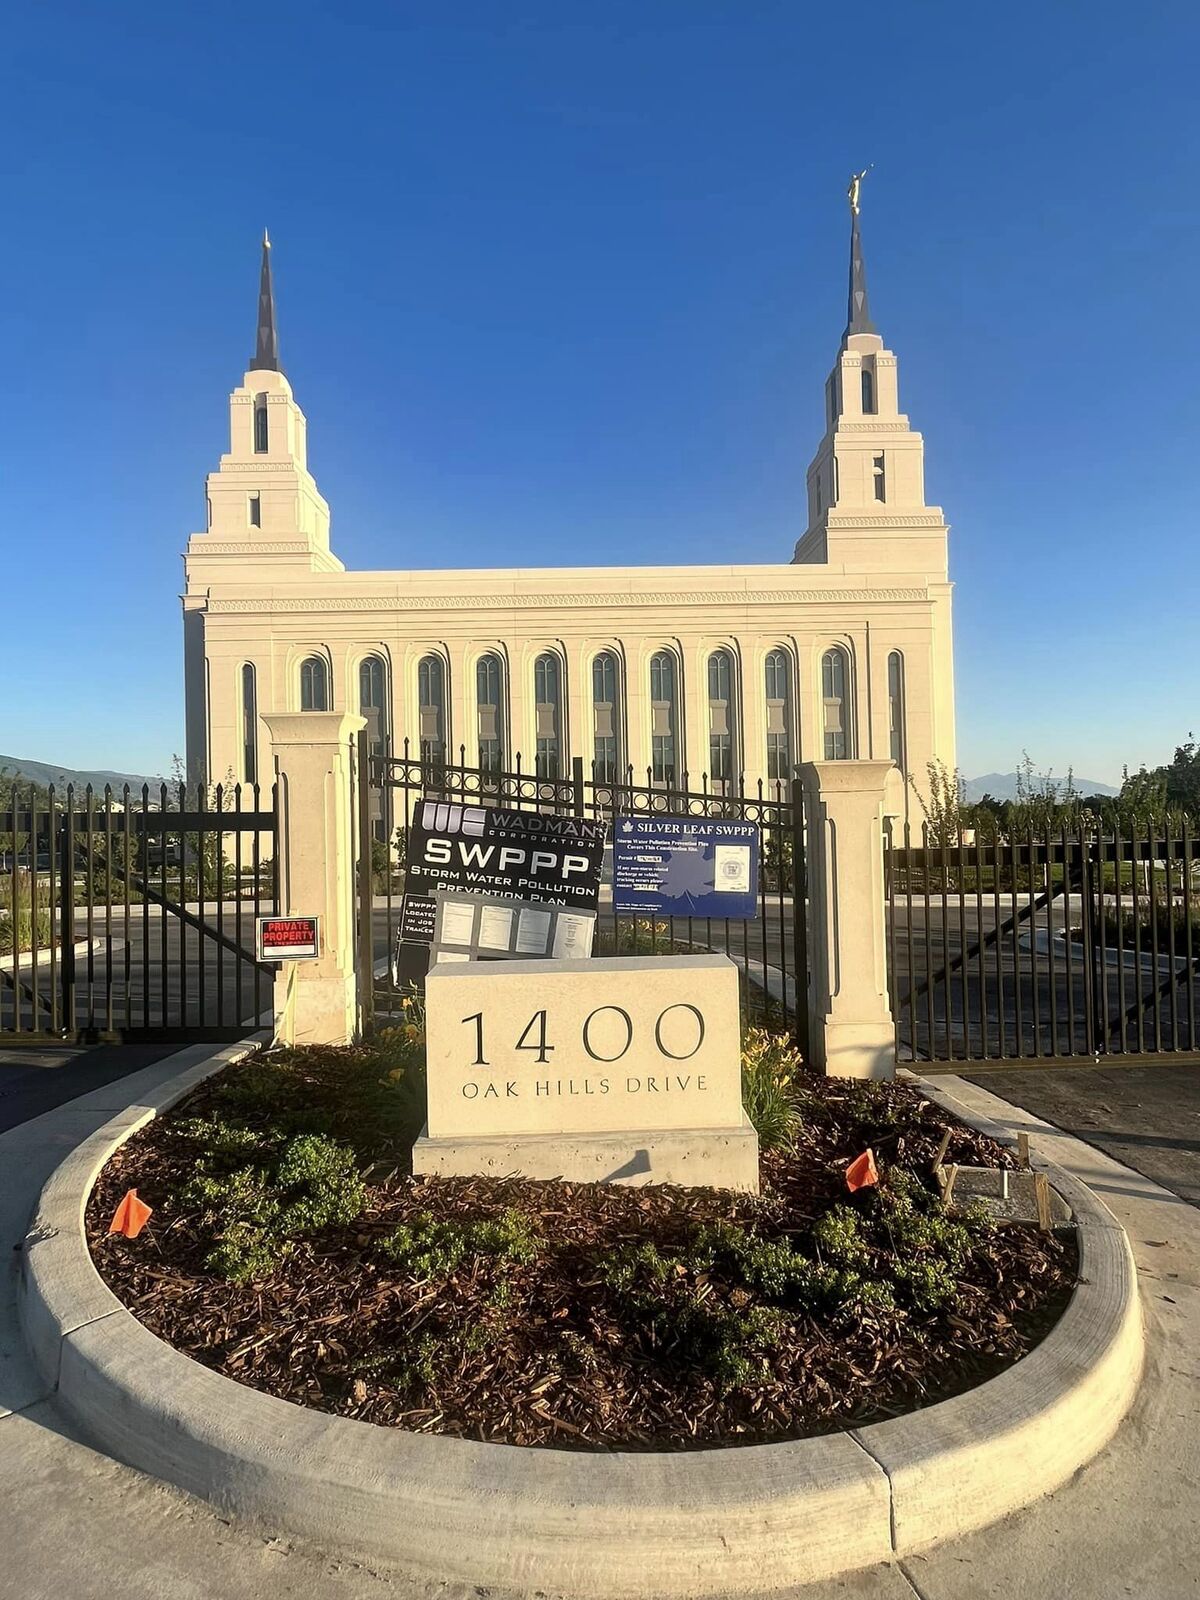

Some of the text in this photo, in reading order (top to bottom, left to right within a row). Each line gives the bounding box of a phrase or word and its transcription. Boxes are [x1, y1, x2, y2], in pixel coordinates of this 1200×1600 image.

[491, 813, 597, 838] WADMAN
[637, 823, 755, 837] SILVER LEAF SWPPP
[489, 830, 596, 848] CORPORATION
[424, 838, 589, 879] SWPPP
[263, 930, 314, 941] PROPERTY
[268, 921, 310, 932] PRIVATE
[461, 1003, 705, 1065] 1400
[462, 1075, 708, 1099] OAK HILLS DRIVE
